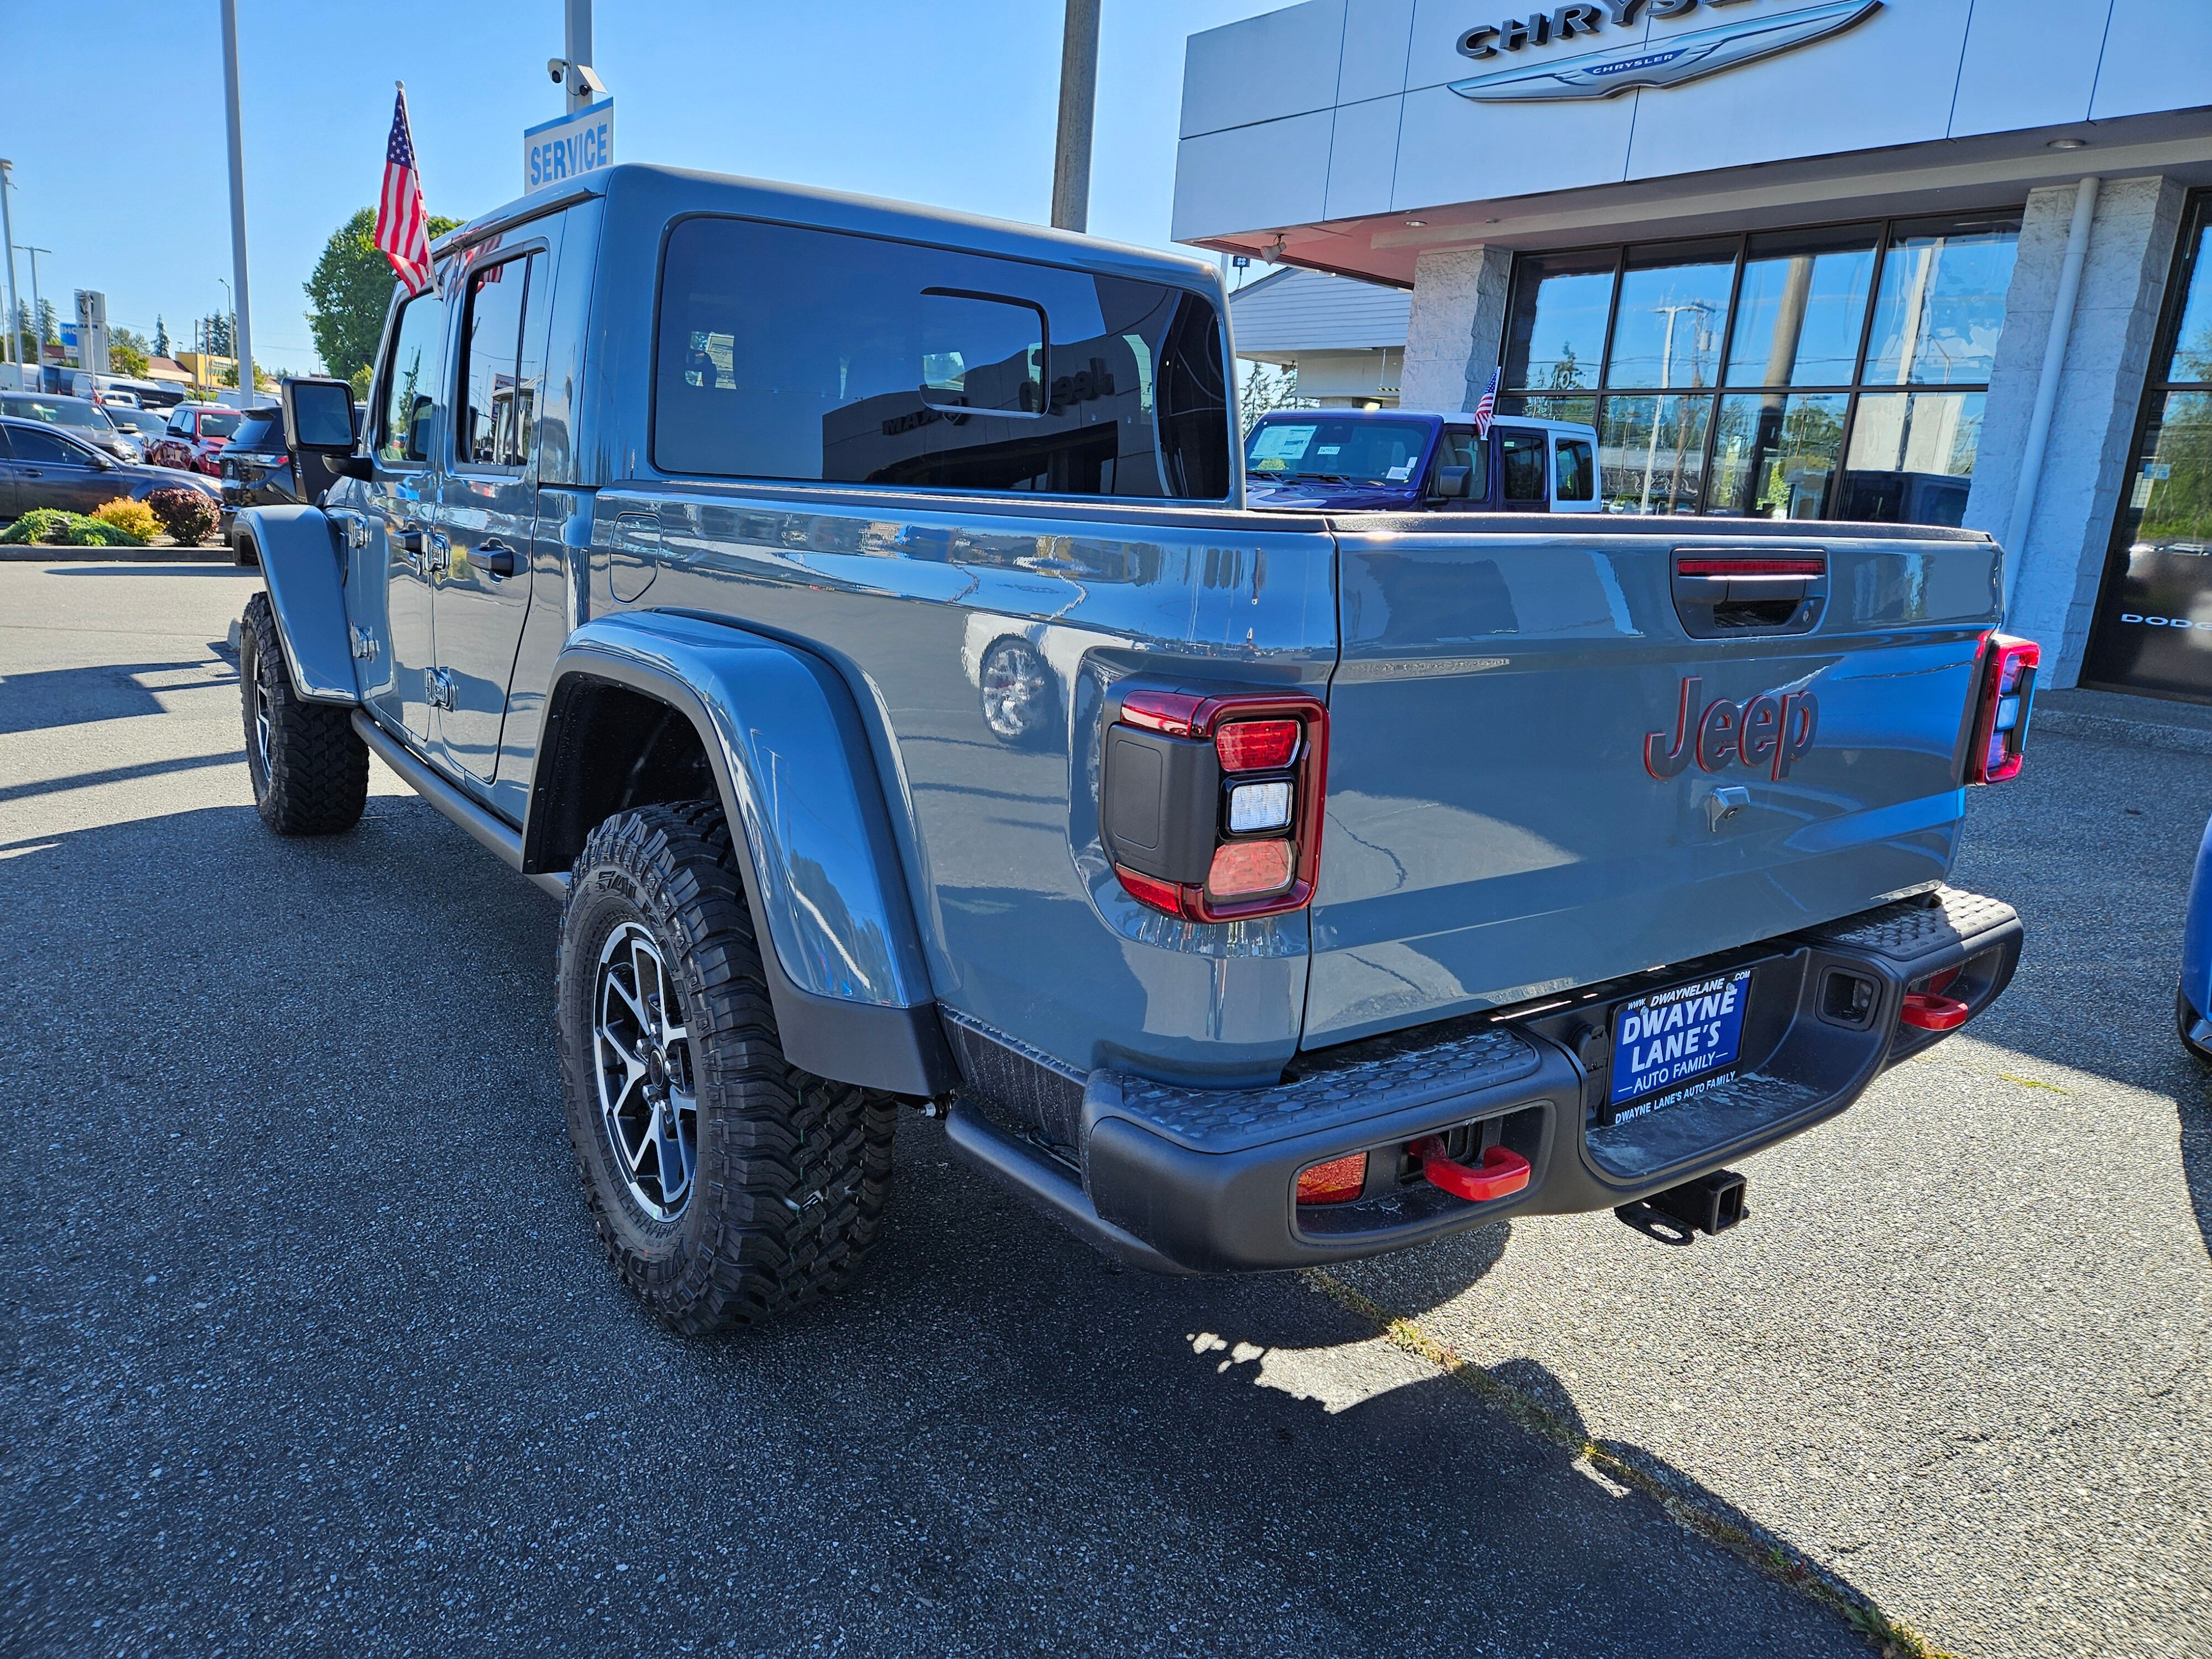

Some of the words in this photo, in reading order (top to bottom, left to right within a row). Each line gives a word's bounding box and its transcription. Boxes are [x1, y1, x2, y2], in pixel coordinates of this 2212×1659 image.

[1593, 54, 1673, 74] CHRYSLER
[531, 123, 607, 186] SERVICE
[1644, 676, 1819, 781] Jeep
[1650, 978, 1725, 1008] DWAYNELANE
[1733, 970, 1751, 982] .COM
[1622, 988, 1738, 1045] DWAYNE
[1631, 1020, 1721, 1073] LANE'S
[1633, 1067, 1669, 1094] AUTO
[1673, 1051, 1716, 1078] FAMILY
[1615, 1102, 1652, 1124] DWAYNE
[1653, 1091, 1682, 1110] LANE'S
[1683, 1083, 1705, 1099] AUTO
[1706, 1070, 1736, 1091] FAMILY
